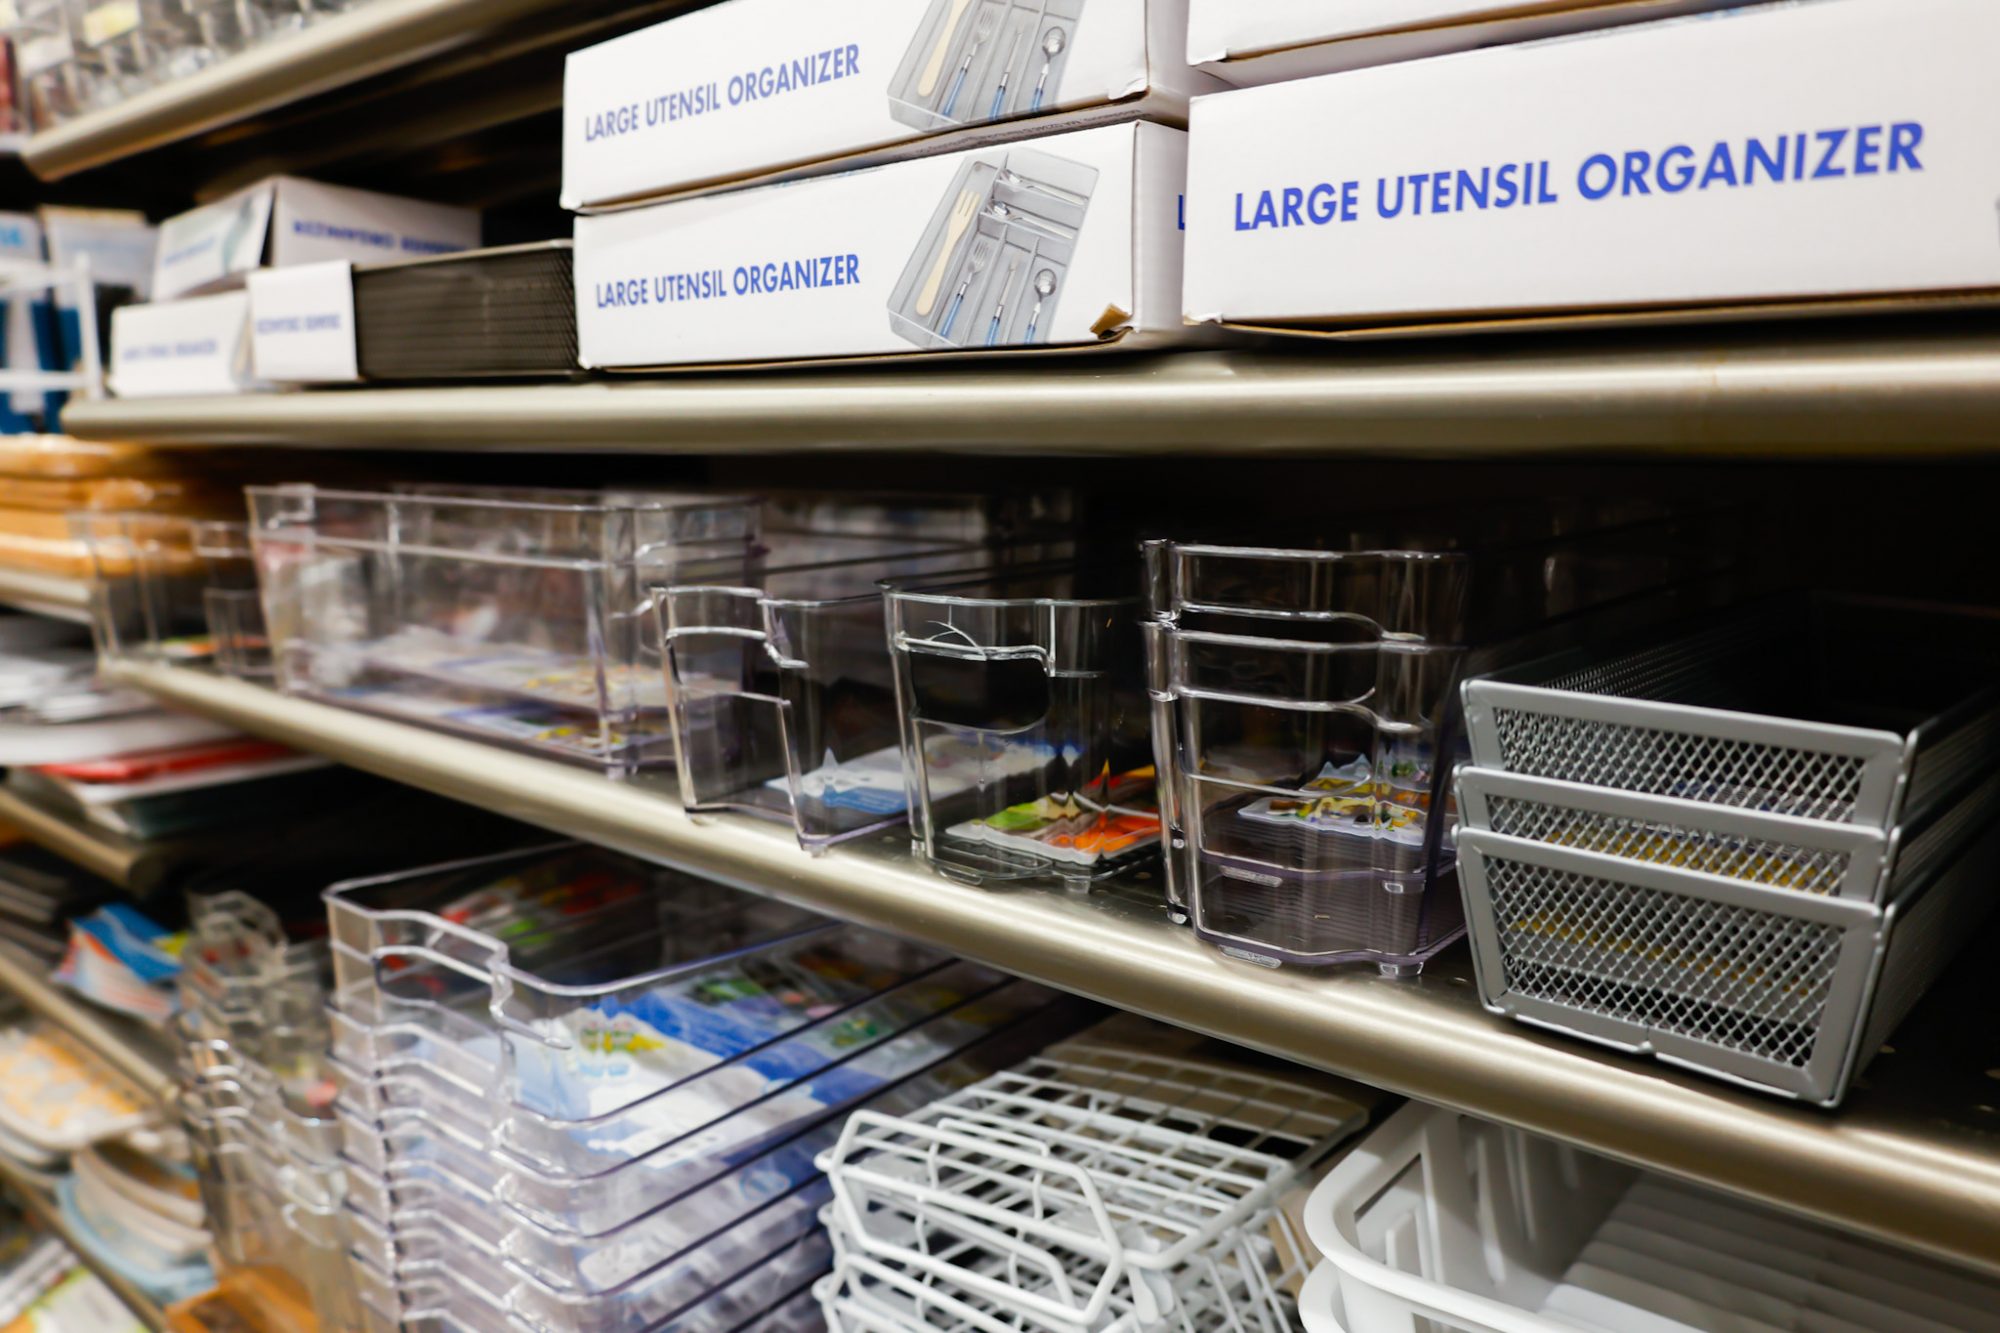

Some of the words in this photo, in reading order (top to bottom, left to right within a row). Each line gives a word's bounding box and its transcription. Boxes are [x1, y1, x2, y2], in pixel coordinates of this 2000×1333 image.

[585, 104, 639, 142] LARGE
[646, 82, 721, 127] UTENSIL
[727, 44, 860, 107] ORGANIZER
[1233, 179, 1361, 233] LARGE
[1376, 159, 1559, 219] UTENSIL
[1576, 120, 1925, 203] ORGANIZER
[596, 278, 648, 310] LARGE
[655, 269, 727, 304] UTENSIL
[733, 253, 860, 296] ORGANIZER
